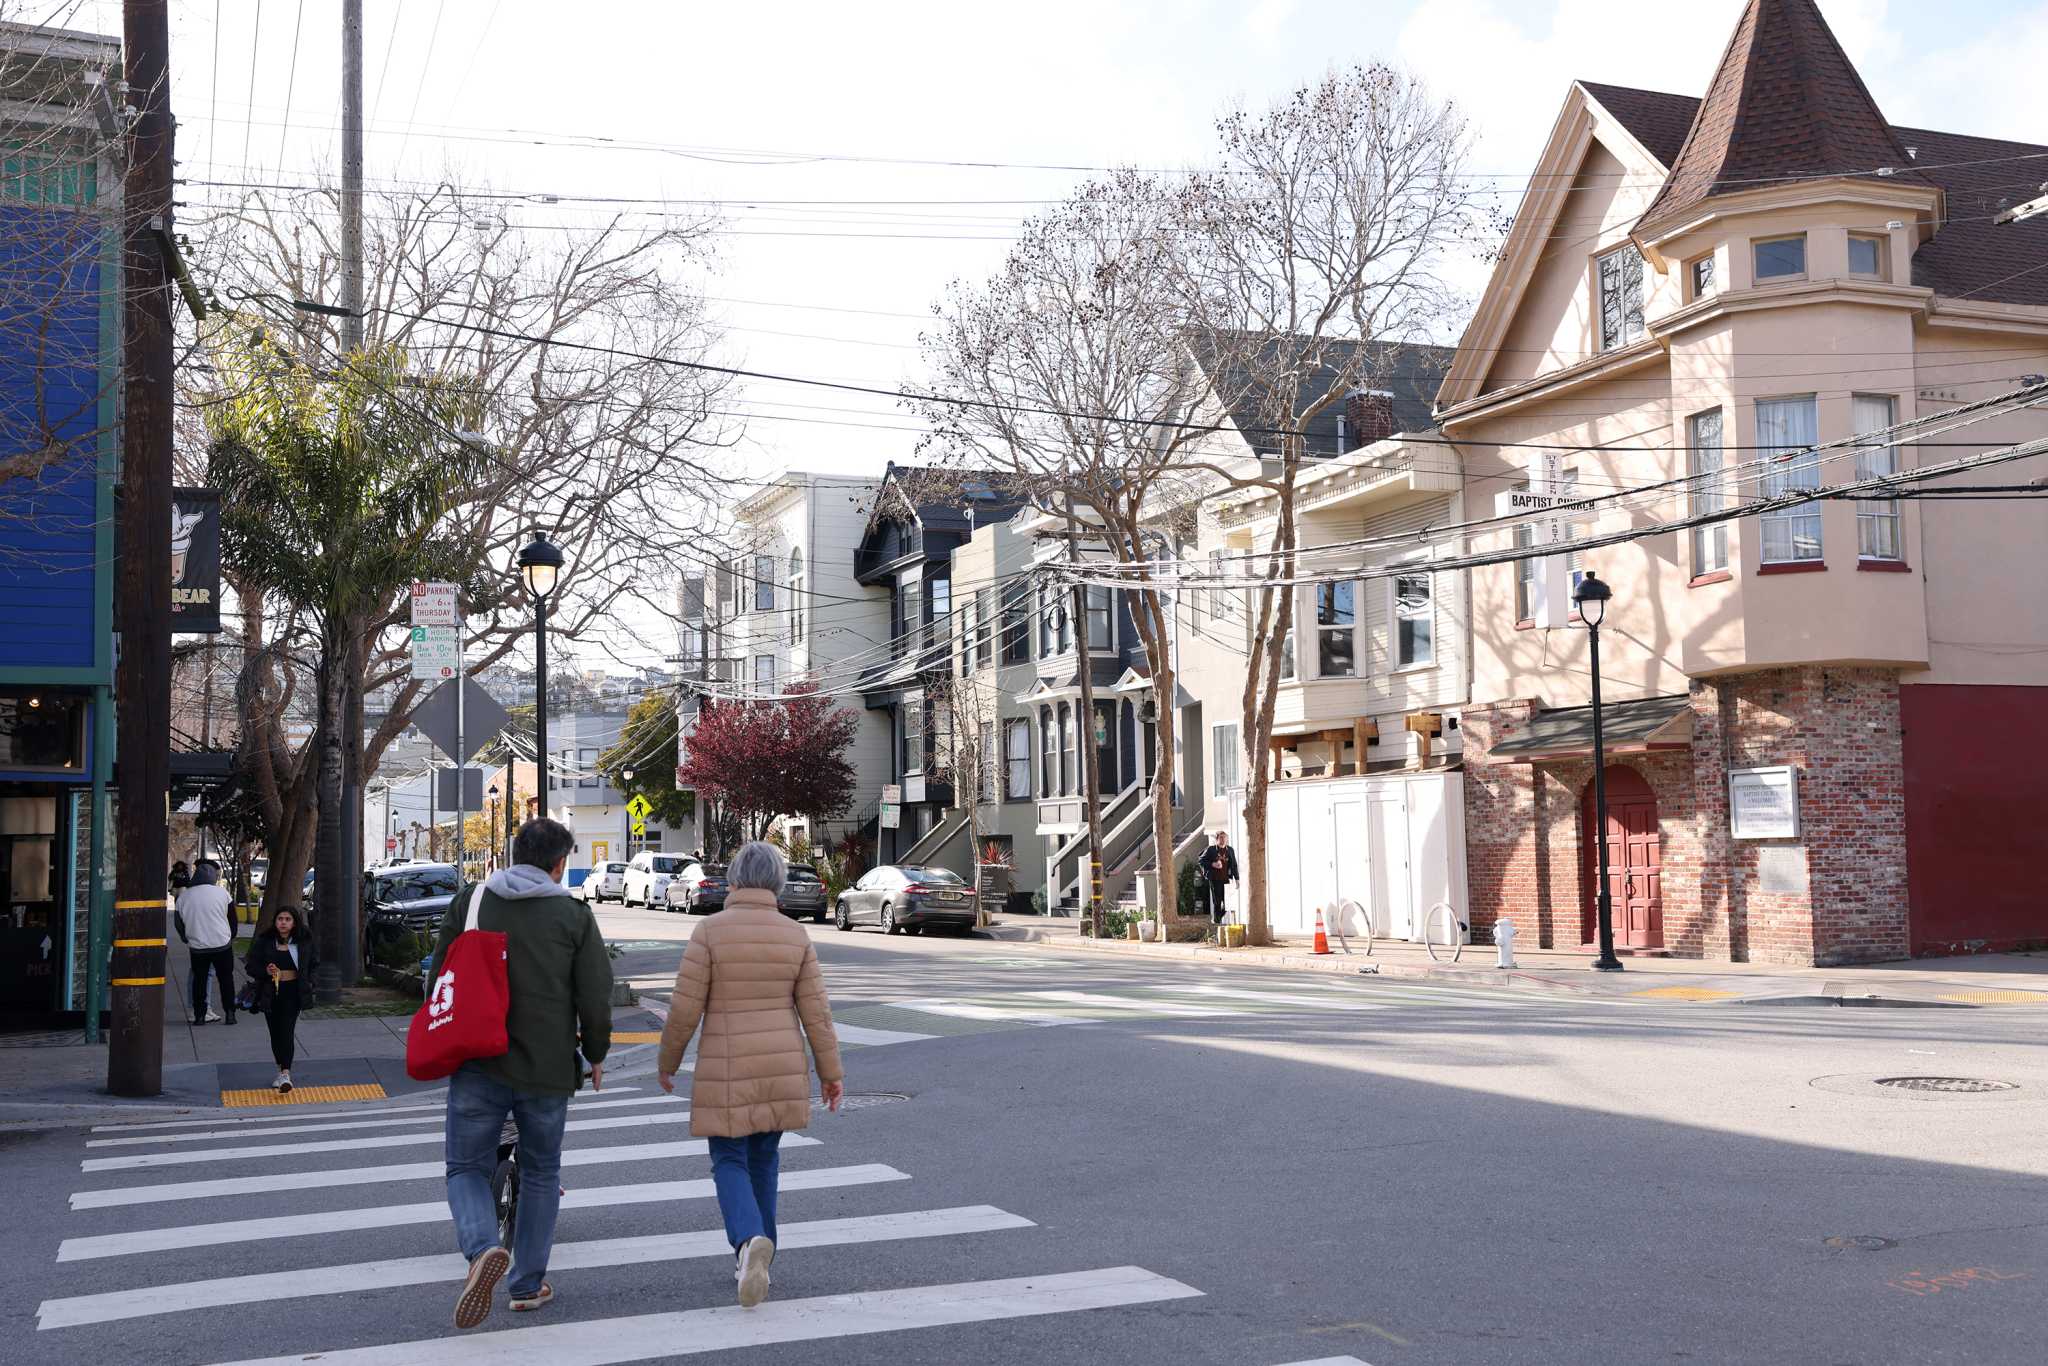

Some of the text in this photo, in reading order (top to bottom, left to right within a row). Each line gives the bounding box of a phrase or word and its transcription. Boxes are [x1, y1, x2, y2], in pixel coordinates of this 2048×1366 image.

[1512, 495, 1595, 511] BAPTIST CHURCH
[413, 584, 454, 595] NO PARKING
[172, 588, 210, 604] BEAR
[416, 609, 451, 617] THURSDAY
[415, 629, 423, 640] 2
